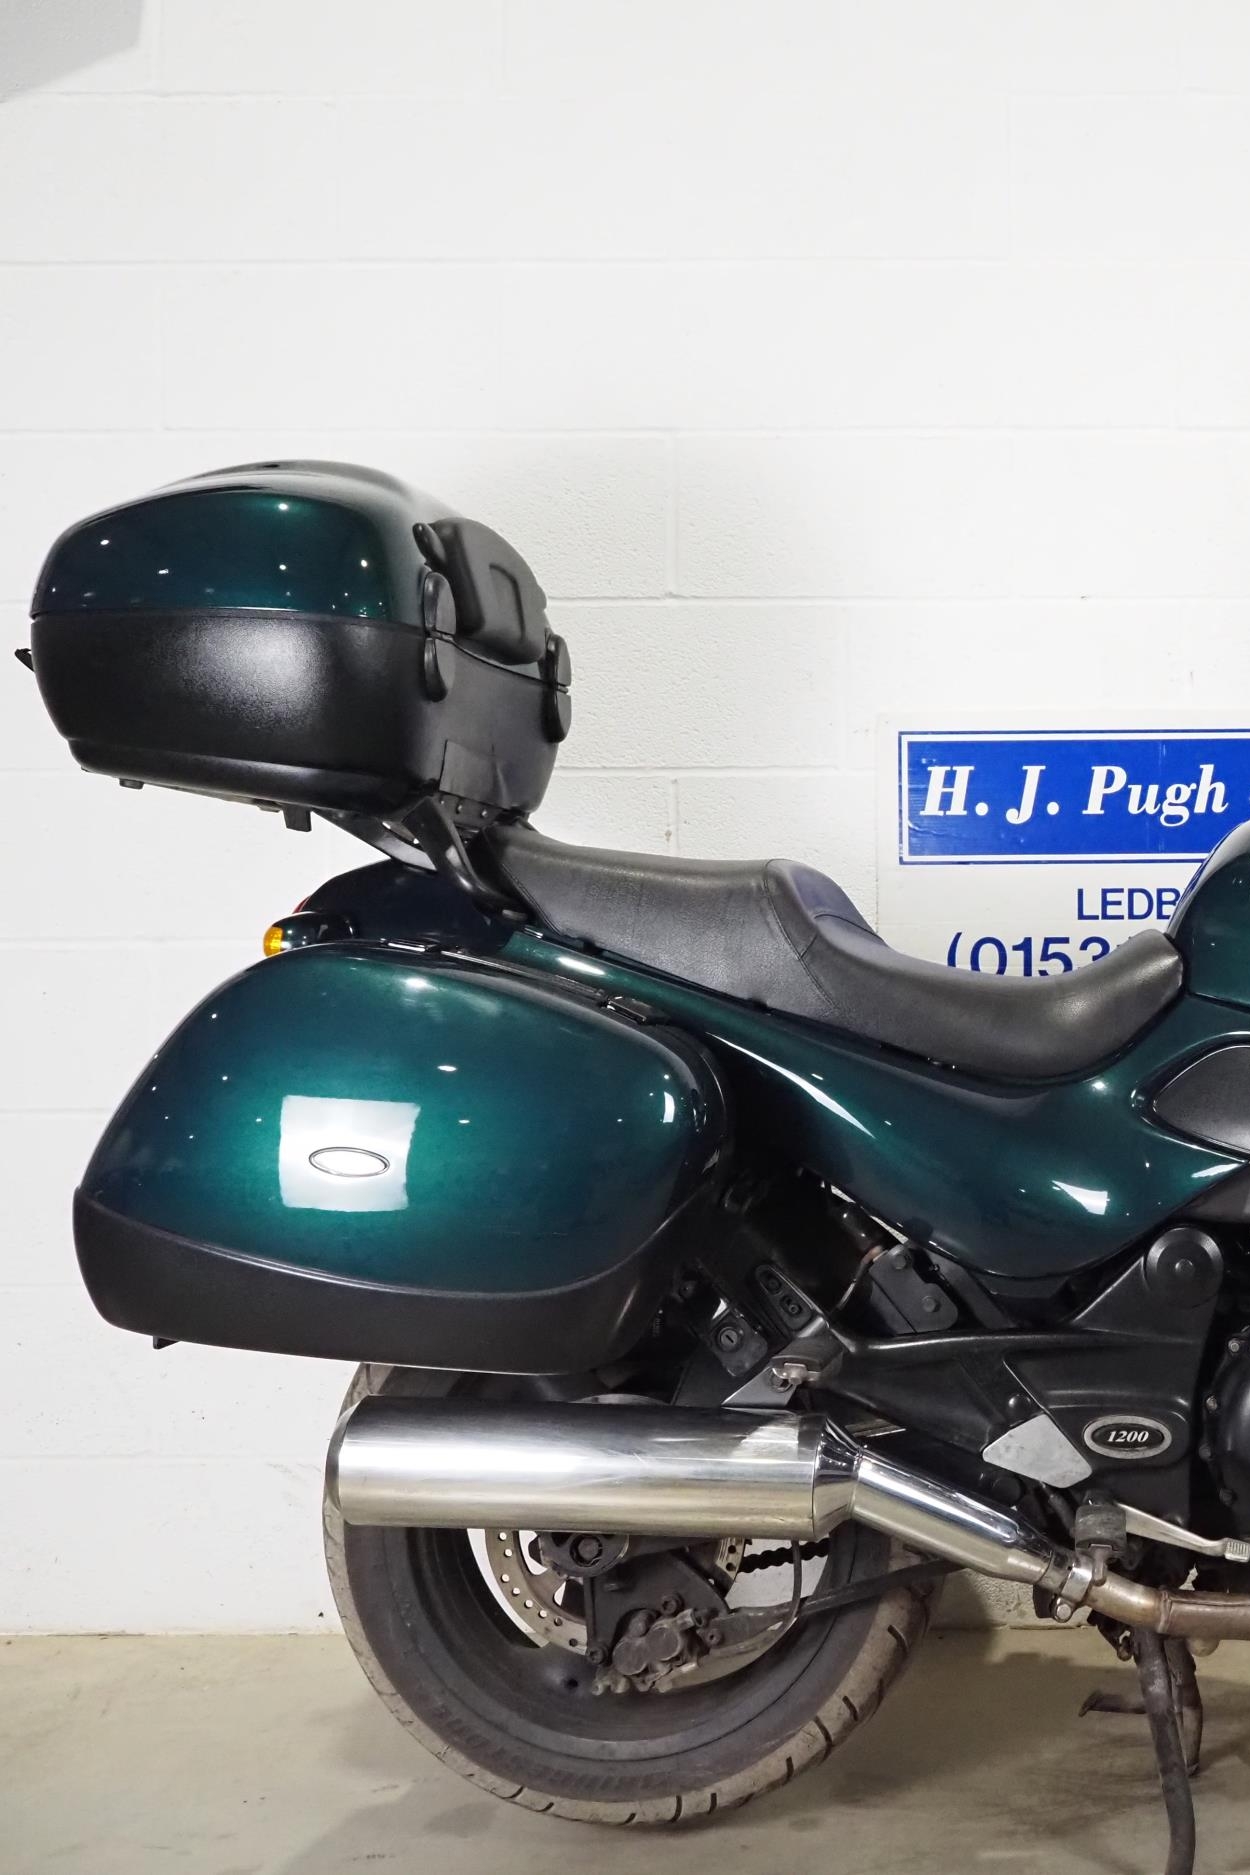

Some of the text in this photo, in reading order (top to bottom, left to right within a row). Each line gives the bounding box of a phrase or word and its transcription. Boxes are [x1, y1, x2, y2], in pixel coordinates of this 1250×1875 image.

[920, 765, 989, 816] H.
[1005, 765, 1060, 825] J.
[1082, 763, 1229, 827] Pugh
[1107, 1430, 1149, 1443] 1200
